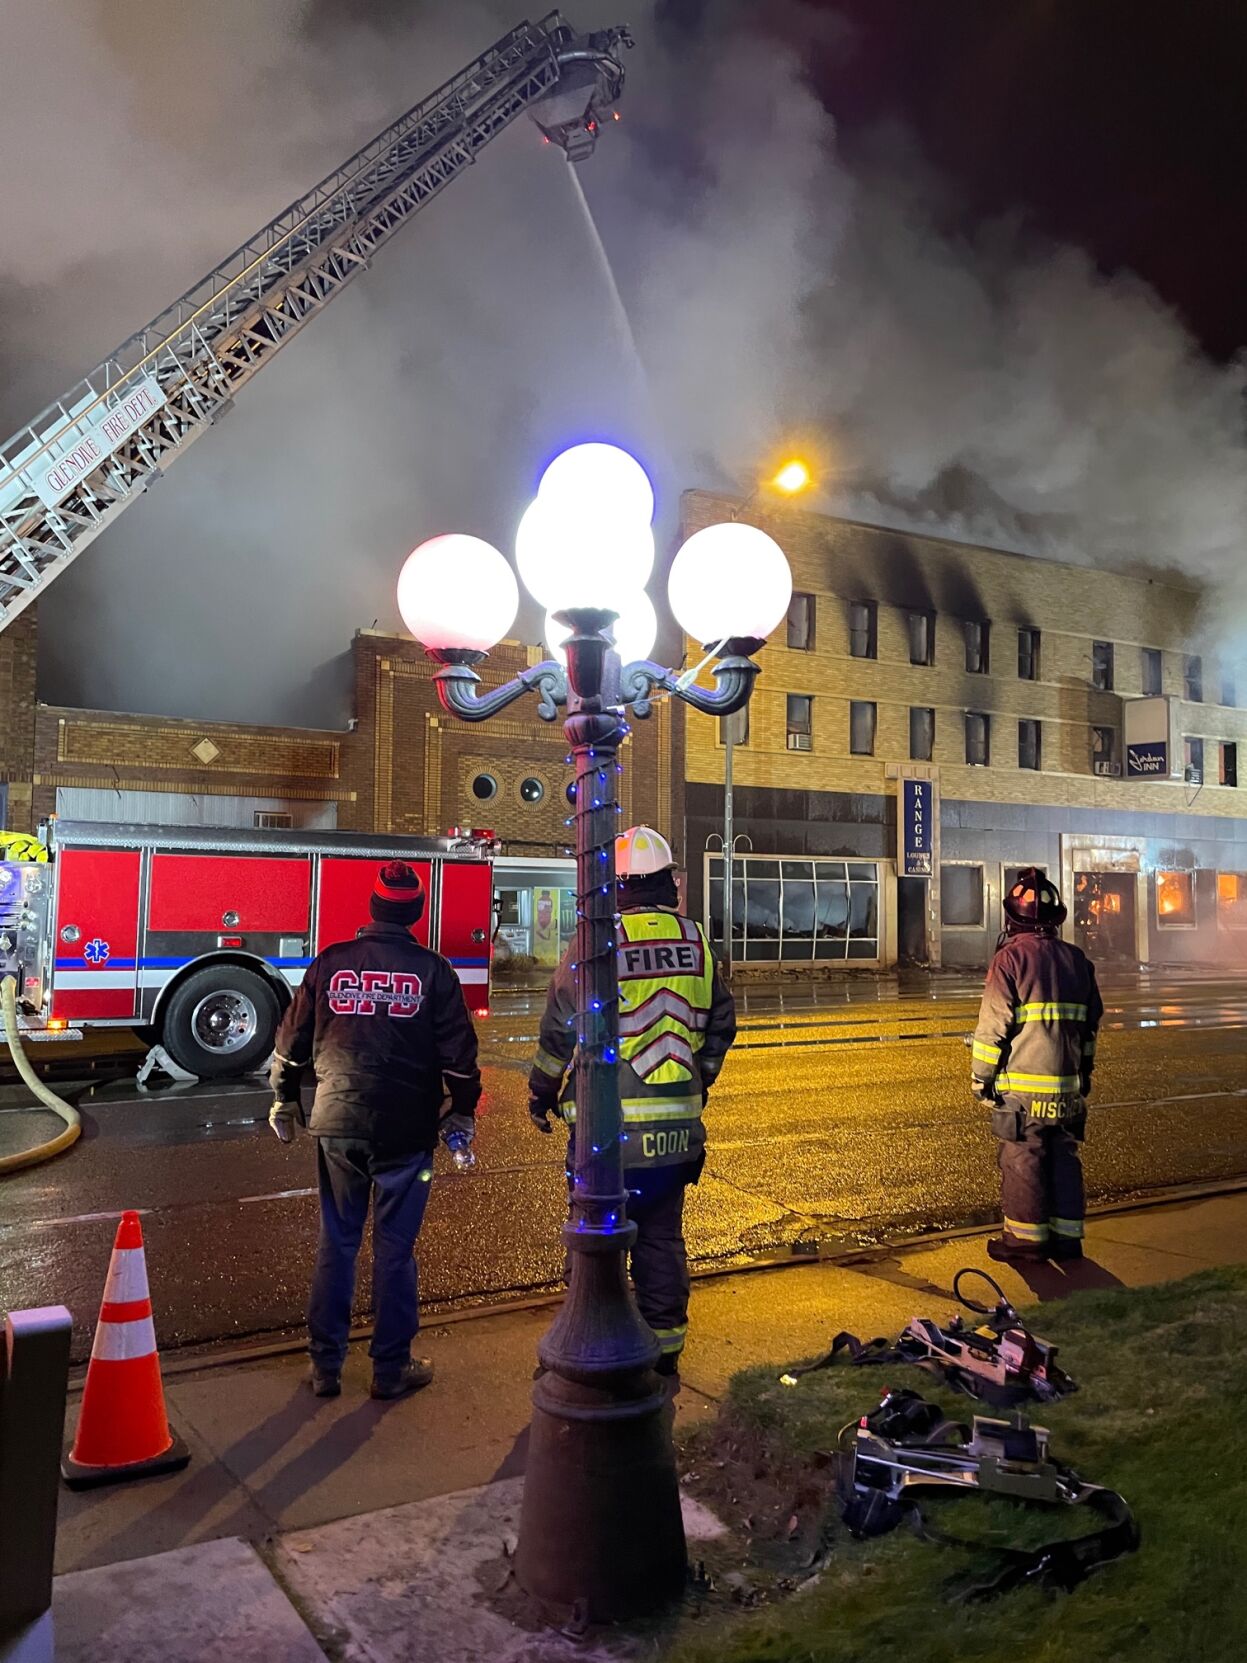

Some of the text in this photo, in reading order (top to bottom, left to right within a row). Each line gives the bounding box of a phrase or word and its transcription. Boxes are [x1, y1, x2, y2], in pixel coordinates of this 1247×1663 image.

[46, 436, 101, 492] GLENDIVE
[102, 411, 131, 444] FIRE
[1128, 749, 1164, 772] Jordan
[1143, 762, 1160, 771] INN
[914, 784, 923, 848] RANGE
[625, 946, 694, 972] FIRE
[329, 970, 422, 1018] GFD
[642, 1129, 690, 1157] COON
